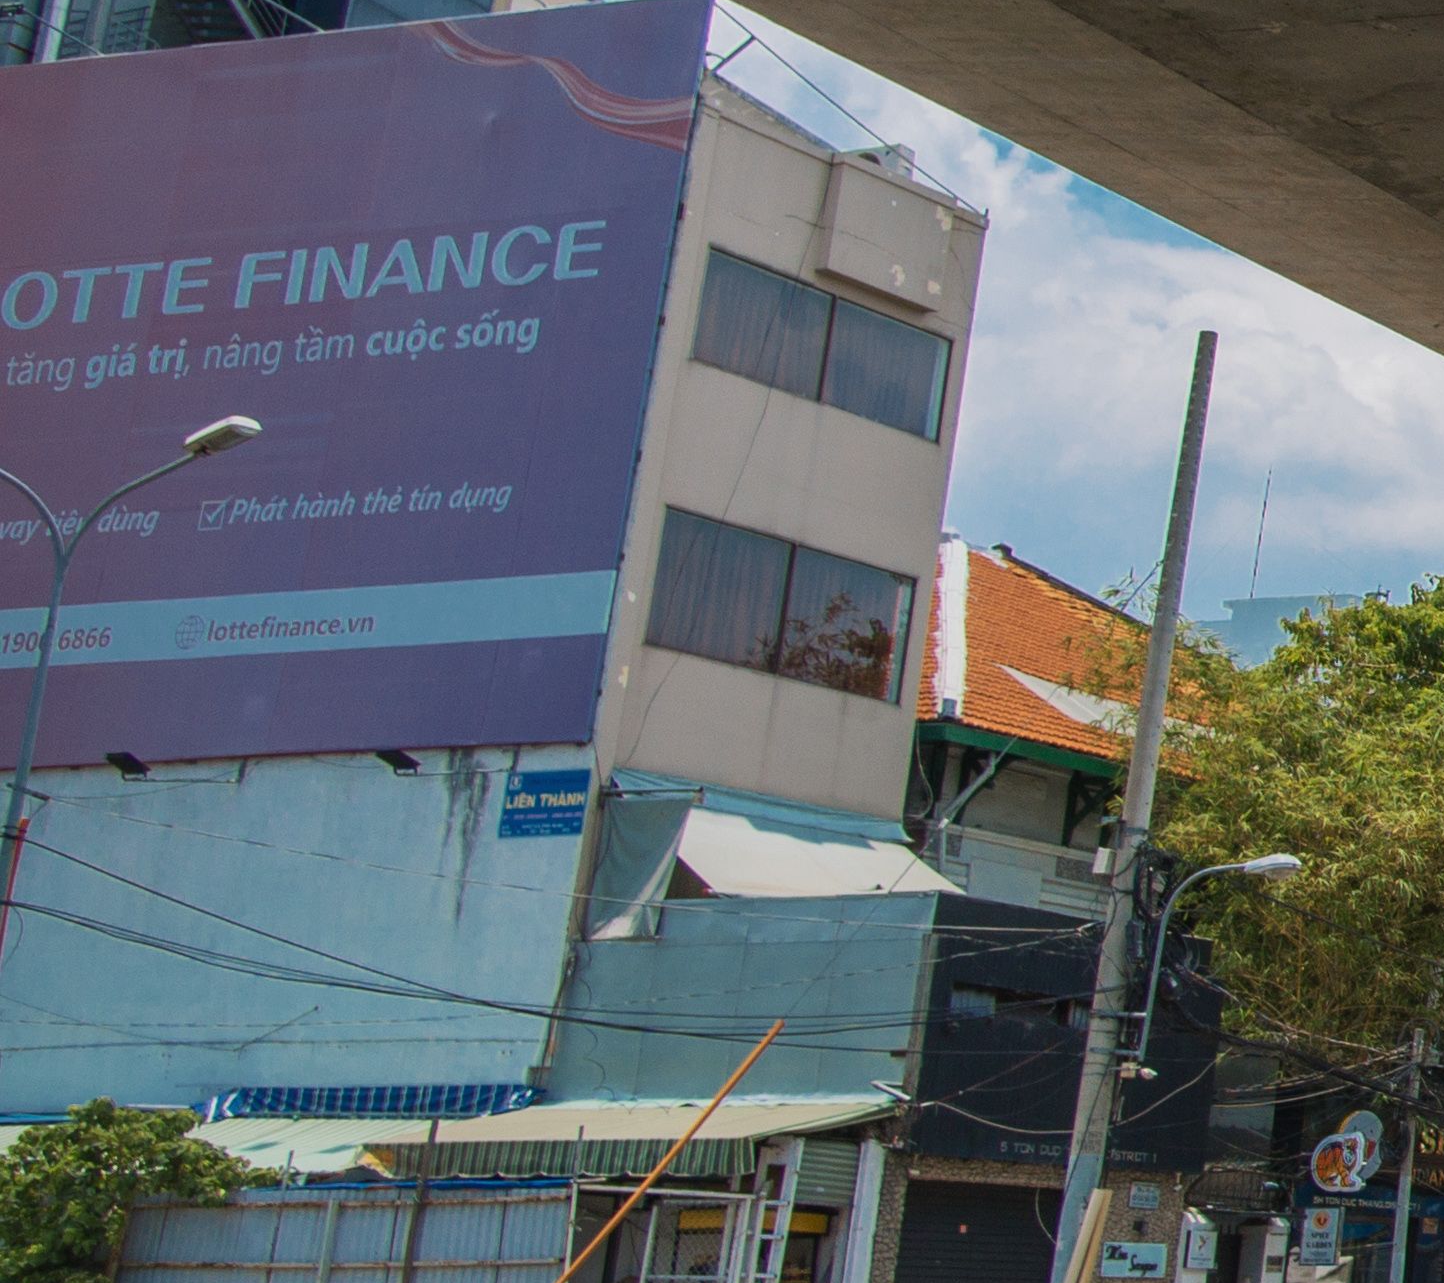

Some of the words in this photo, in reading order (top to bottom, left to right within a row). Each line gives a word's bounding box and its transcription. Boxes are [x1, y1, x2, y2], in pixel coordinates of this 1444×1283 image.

[234, 220, 607, 309] FINANCE
[6, 351, 76, 391] tăng
[84, 342, 138, 389] giá
[149, 337, 190, 380] trị,
[203, 332, 284, 375] nâng
[295, 325, 355, 363] tầm
[366, 318, 447, 360] cuộc
[455, 308, 541, 354] sống
[97, 505, 160, 538] dùng
[228, 494, 289, 524] Phát
[292, 490, 356, 519] hành
[363, 486, 403, 515] thẻ
[408, 483, 444, 512] tín
[449, 482, 513, 513] dụng
[58, 627, 112, 650] 6866
[207, 616, 375, 642] lottefinance.vn
